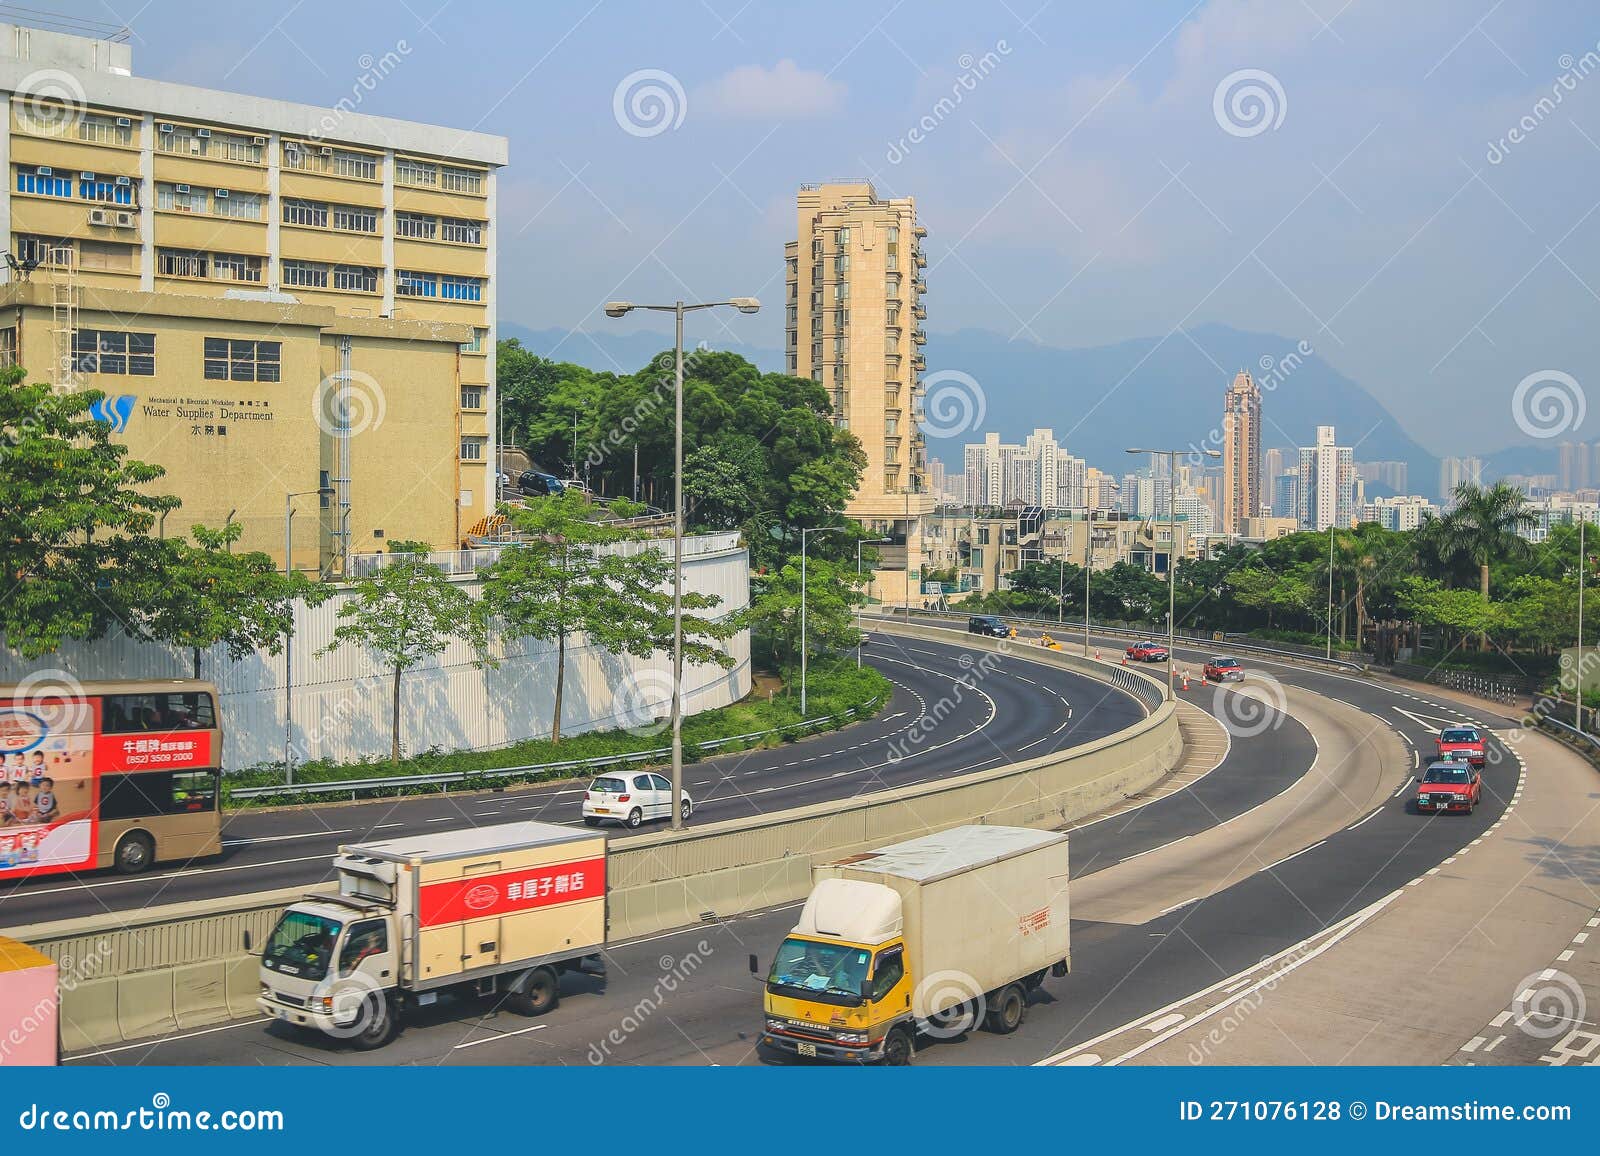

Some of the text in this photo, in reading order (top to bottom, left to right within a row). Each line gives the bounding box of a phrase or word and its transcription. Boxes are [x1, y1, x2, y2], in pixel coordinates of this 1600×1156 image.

[143, 405, 273, 422] Water Supplies Department
[507, 871, 584, 901] 車厘子餅店
